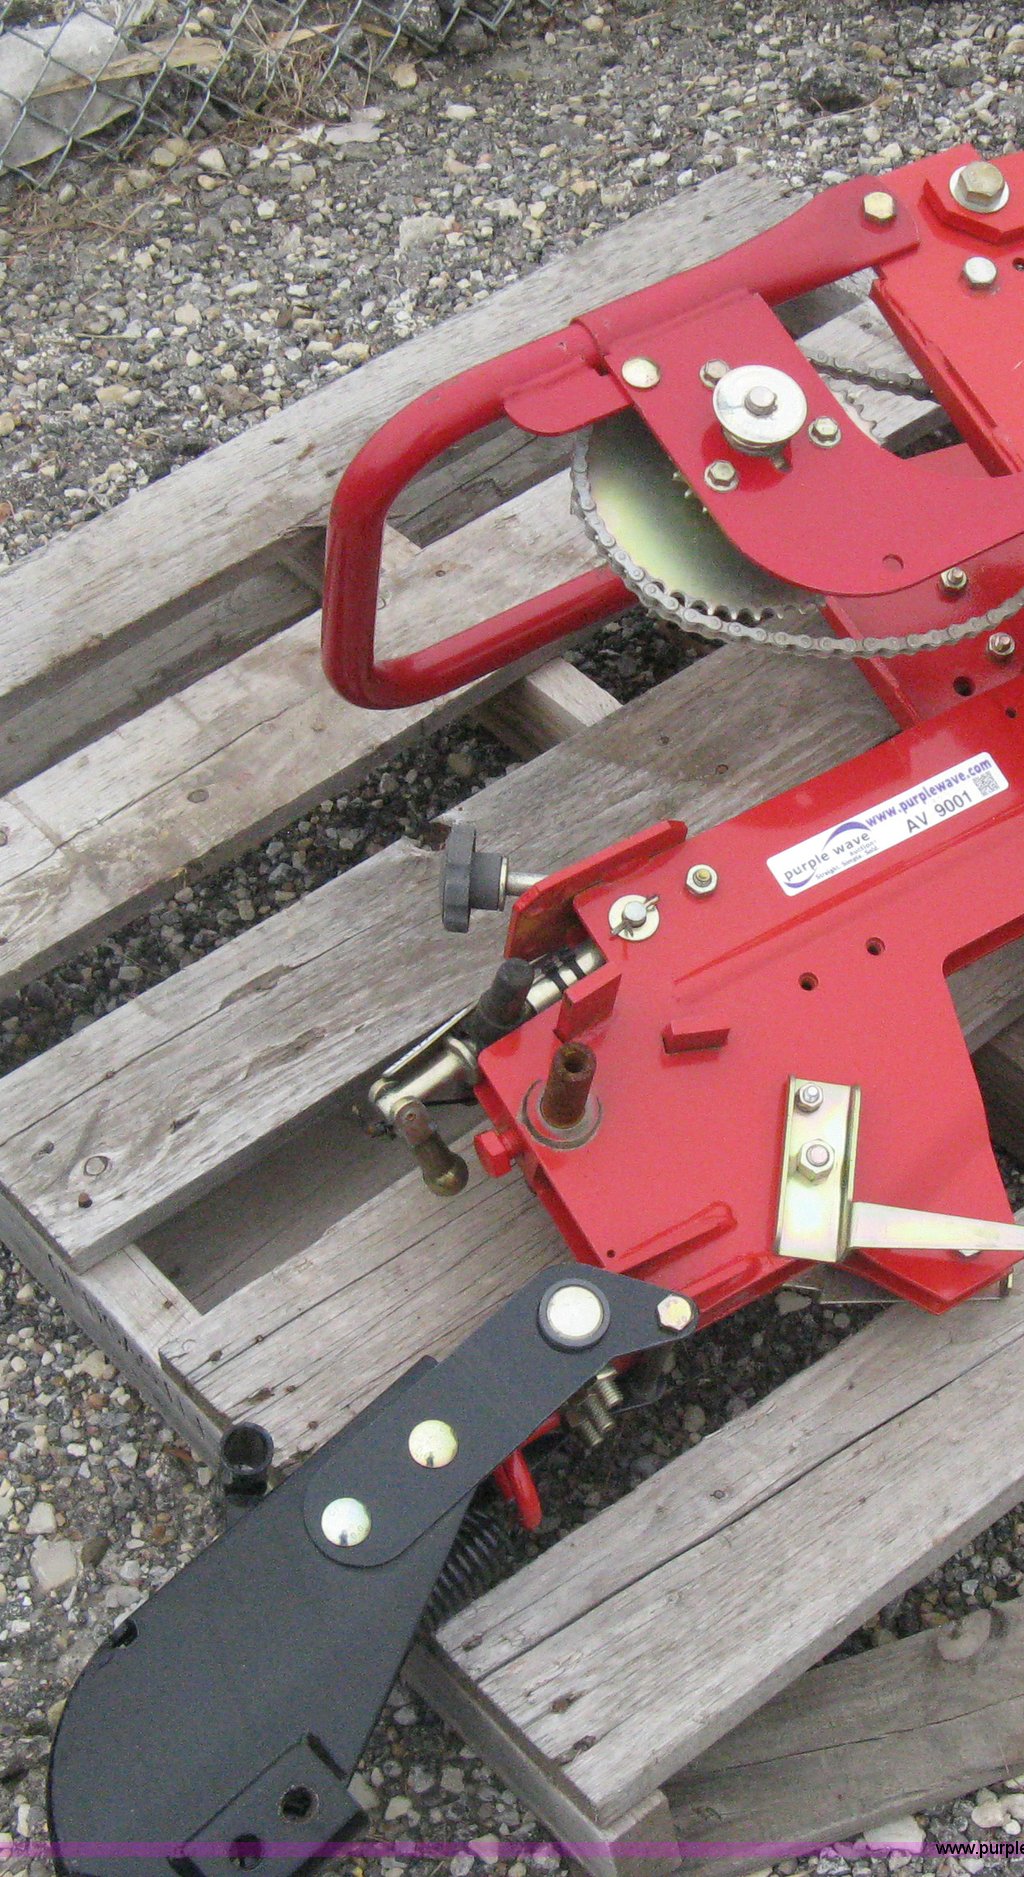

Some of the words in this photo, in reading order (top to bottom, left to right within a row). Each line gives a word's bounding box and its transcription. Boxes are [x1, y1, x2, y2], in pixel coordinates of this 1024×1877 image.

[865, 758, 992, 829] www.purplewave.com
[906, 811, 930, 834] AV
[934, 790, 974, 817] 9001
[783, 851, 830, 882] purple
[833, 832, 871, 854] wave
